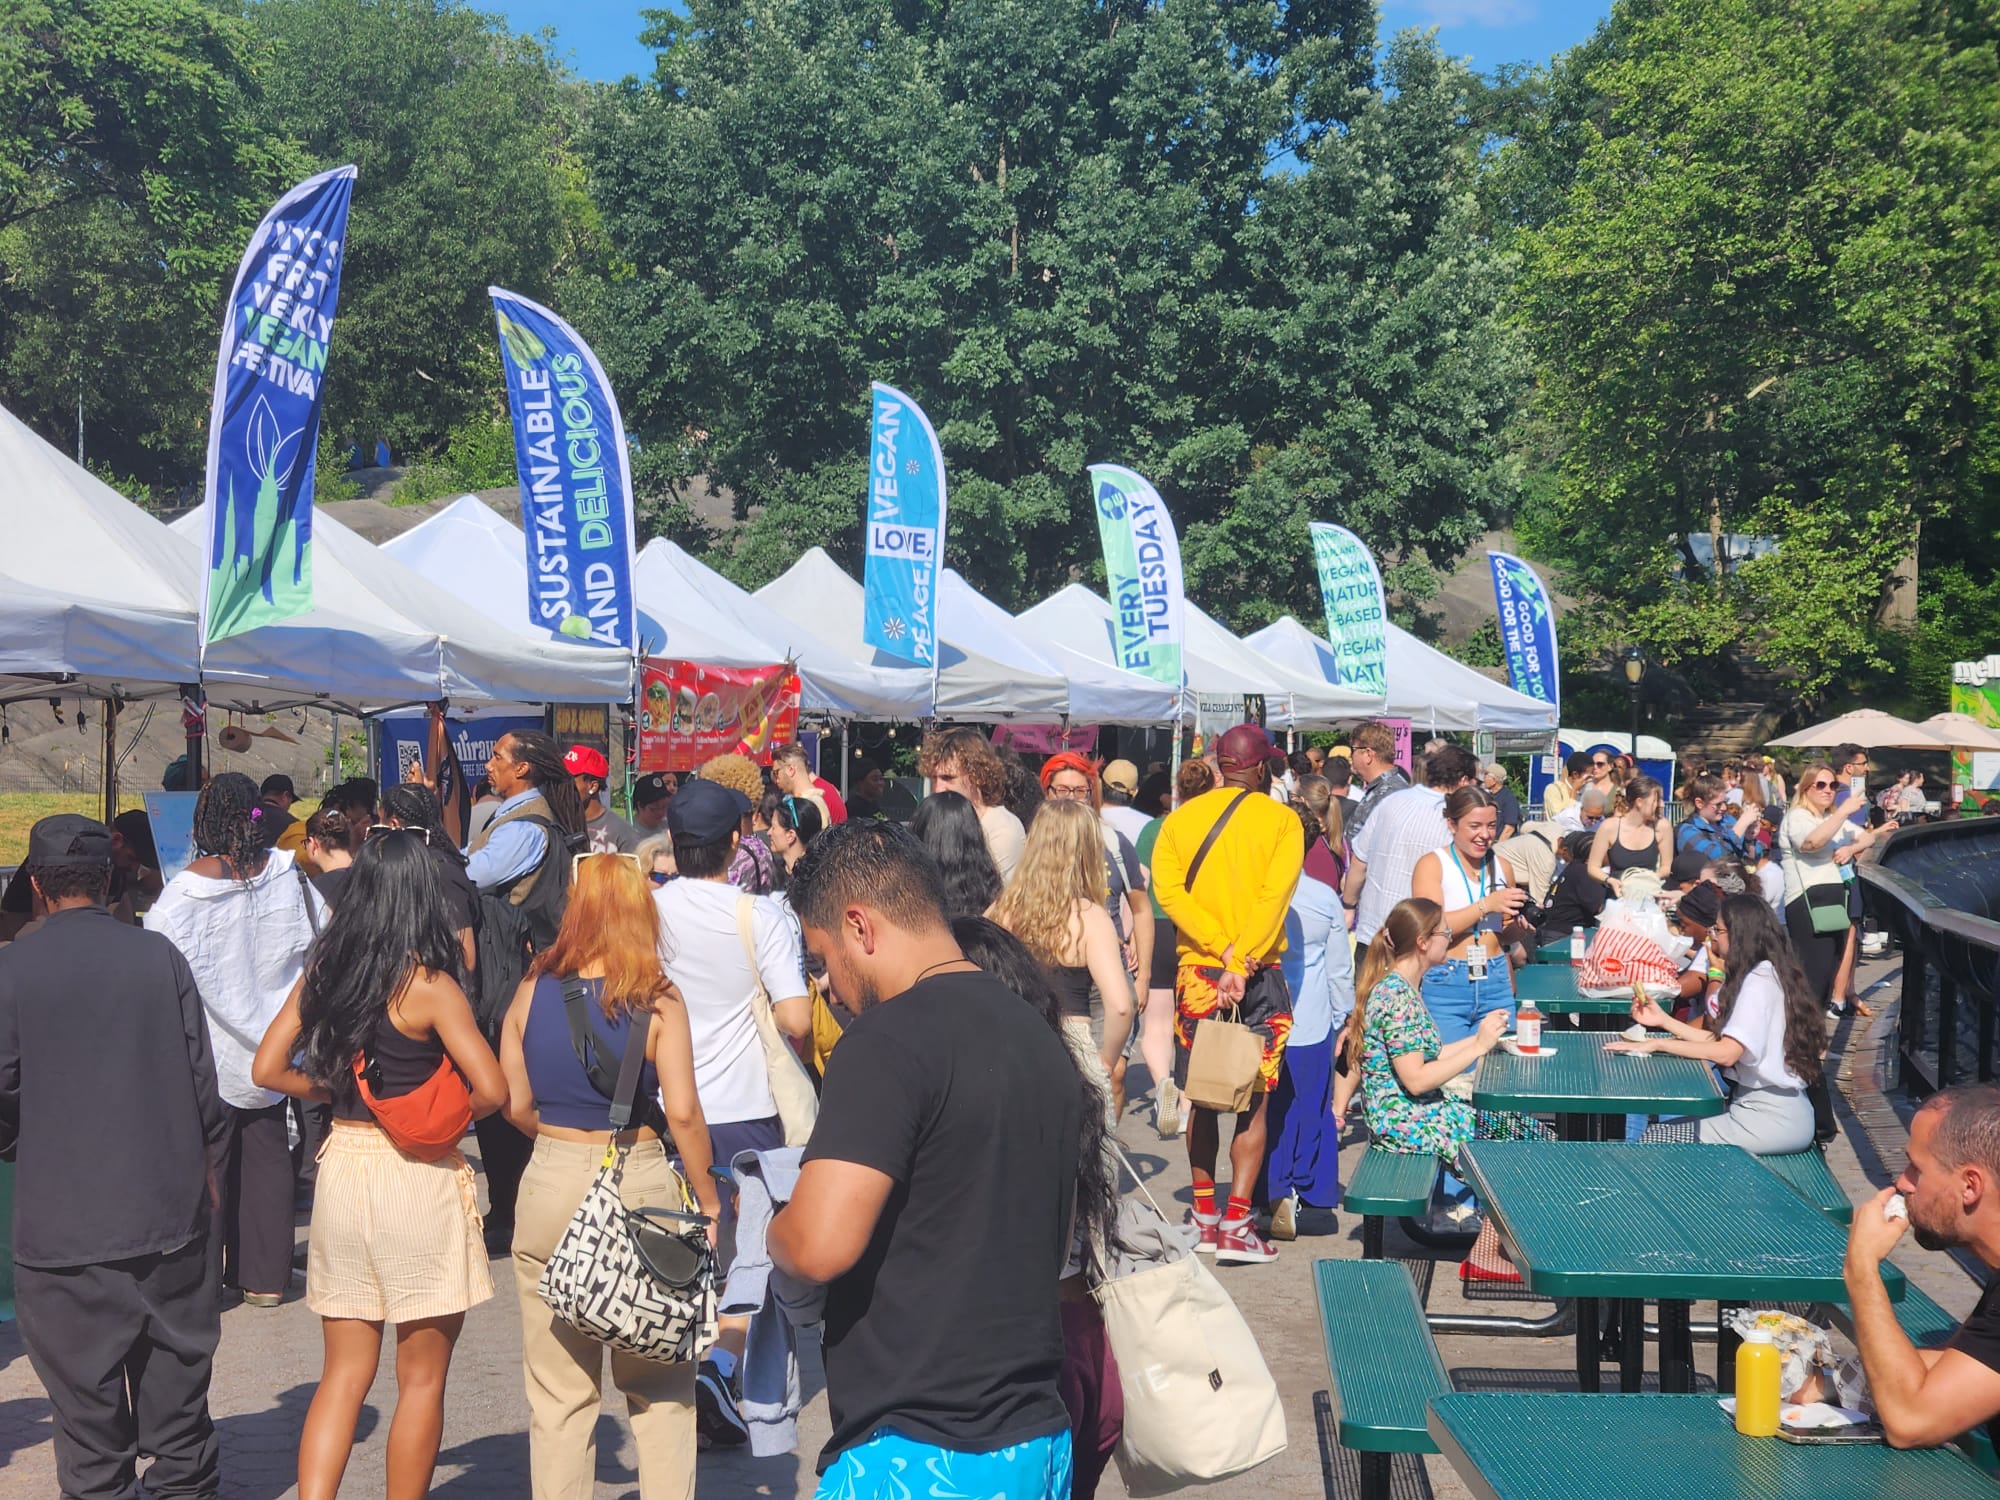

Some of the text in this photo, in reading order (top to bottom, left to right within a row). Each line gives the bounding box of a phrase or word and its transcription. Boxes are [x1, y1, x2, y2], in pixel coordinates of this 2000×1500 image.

[244, 305, 330, 375] VEGAN
[520, 368, 573, 620] SUSTAINABLE
[873, 400, 901, 522] VEGAN
[552, 352, 622, 647] AND DELICIOUS
[874, 526, 933, 557] LOVE,
[1128, 500, 1171, 638] TUESDAY
[1321, 561, 1370, 582] VEGAN
[1117, 573, 1151, 669] EVERY
[1323, 581, 1378, 603] NATUR
[1495, 557, 1530, 697] GOOD FOR THE PLANE
[1518, 599, 1535, 643] GOOD
[1333, 637, 1386, 657] VEGAN
[1525, 645, 1541, 673] FOR
